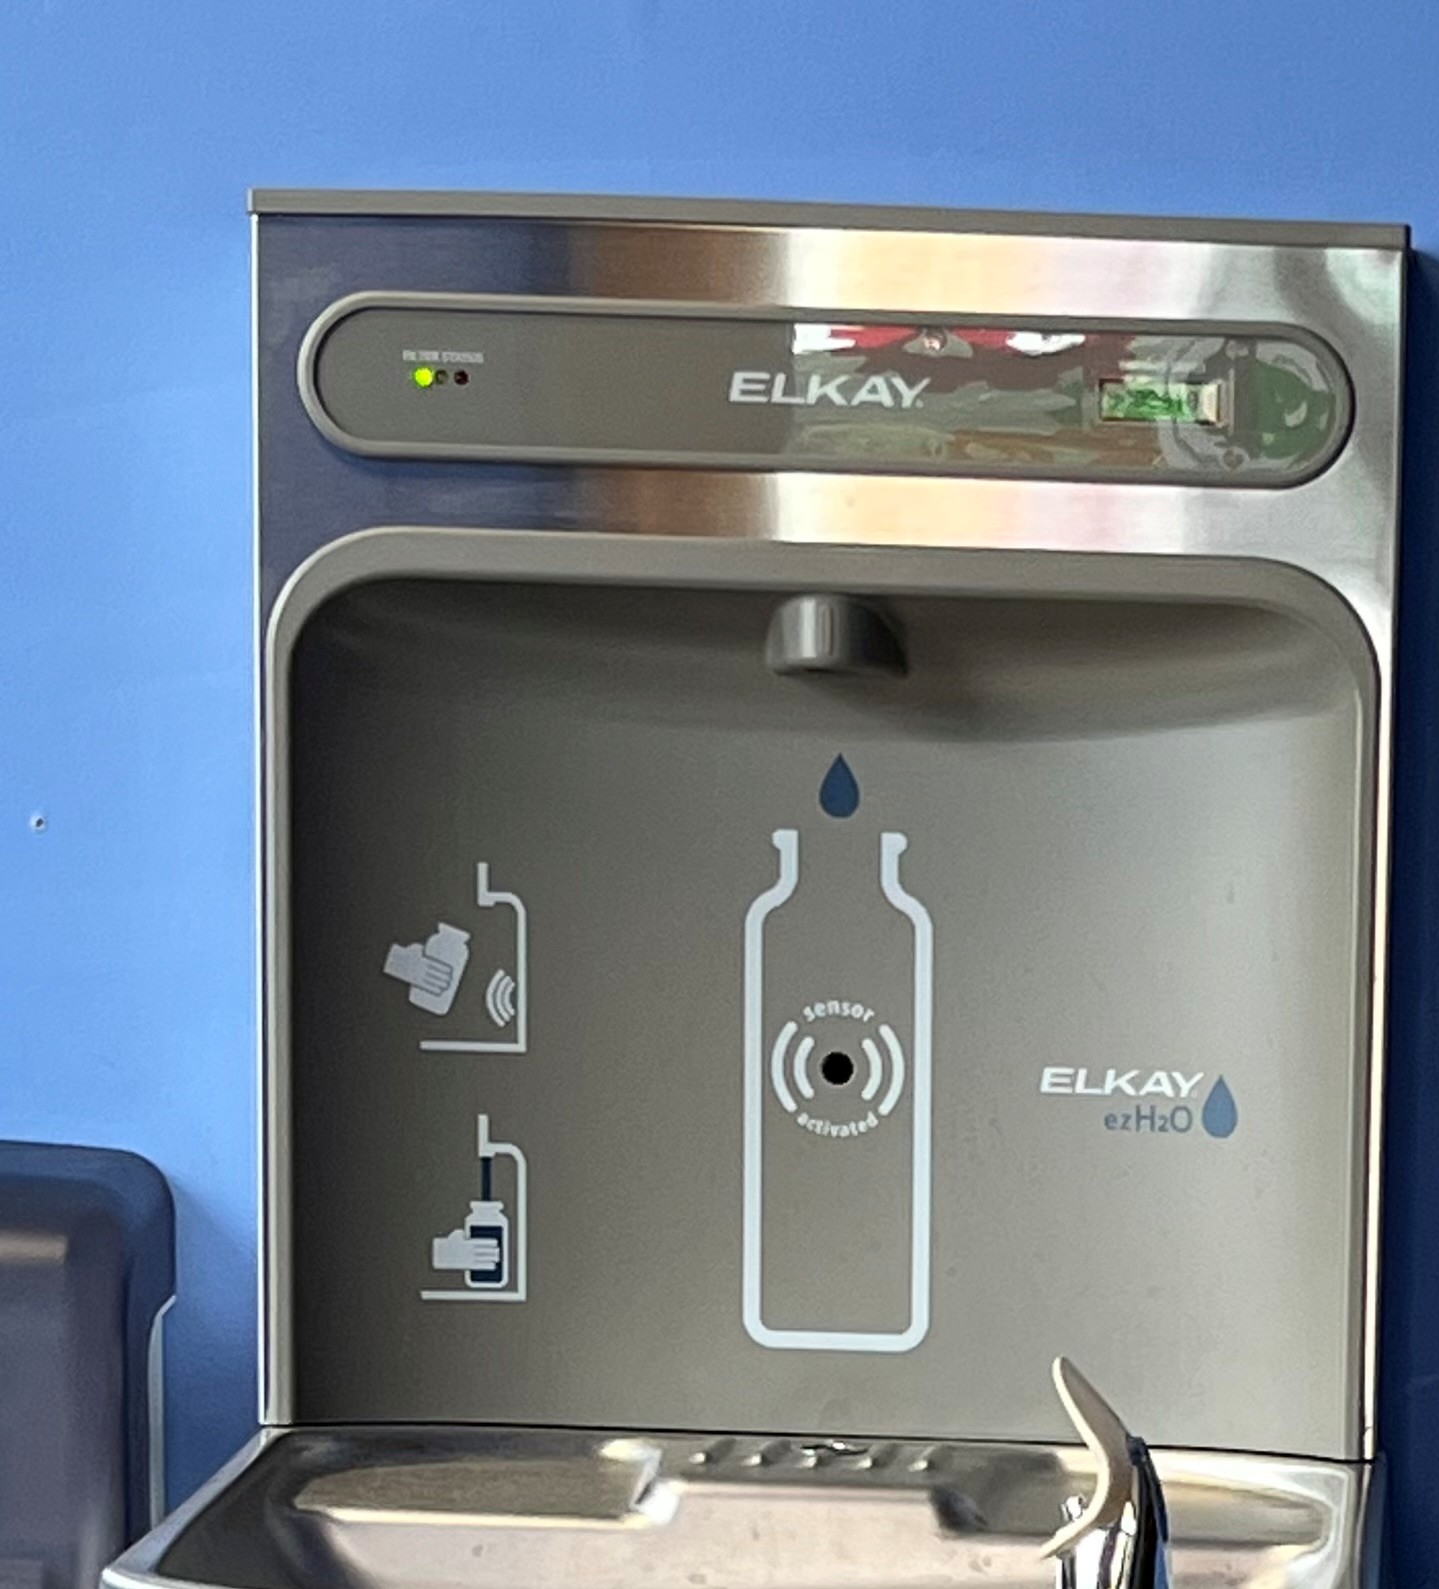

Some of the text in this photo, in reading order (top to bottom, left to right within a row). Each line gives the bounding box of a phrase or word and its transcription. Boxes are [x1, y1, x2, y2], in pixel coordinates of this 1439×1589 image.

[728, 370, 932, 409] ELKAY
[802, 1000, 876, 1022] sensor
[1039, 1066, 1205, 1099] ELKAY
[796, 1110, 879, 1138] activated
